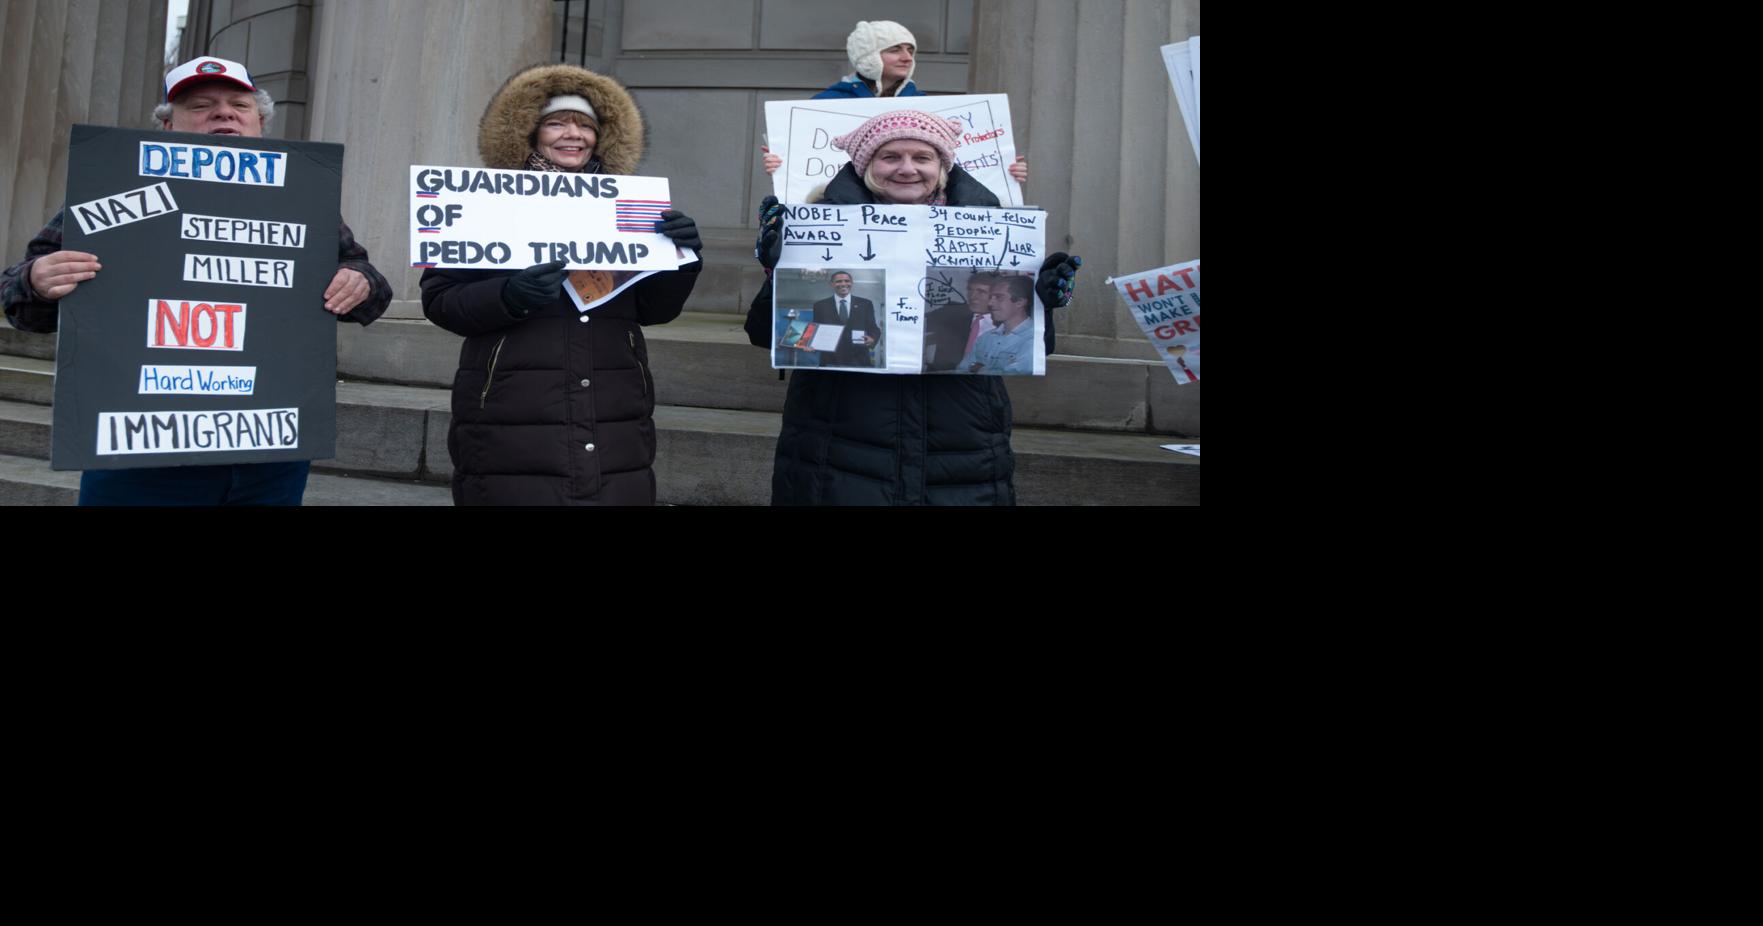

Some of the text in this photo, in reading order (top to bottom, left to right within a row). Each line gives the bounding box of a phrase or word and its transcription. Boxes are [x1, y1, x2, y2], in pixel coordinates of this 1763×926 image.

[142, 144, 282, 184] DEPORT
[416, 169, 619, 198] GUARDIANS
[78, 185, 173, 231] NAZI
[416, 204, 463, 227] OF
[784, 206, 848, 222] NOBEL
[929, 206, 948, 221] 34
[183, 217, 301, 246] STEPHEN
[784, 226, 842, 241] AWARD
[420, 241, 649, 265] PEDO TRUMP
[1008, 241, 1036, 255] LIAR
[192, 255, 290, 286] MILLER
[1137, 295, 1184, 314] WON'T
[1144, 304, 1193, 325] MAKE
[155, 299, 243, 347] NOT
[144, 367, 253, 393] Hard Working
[109, 411, 298, 450] IMMIGRANTS
